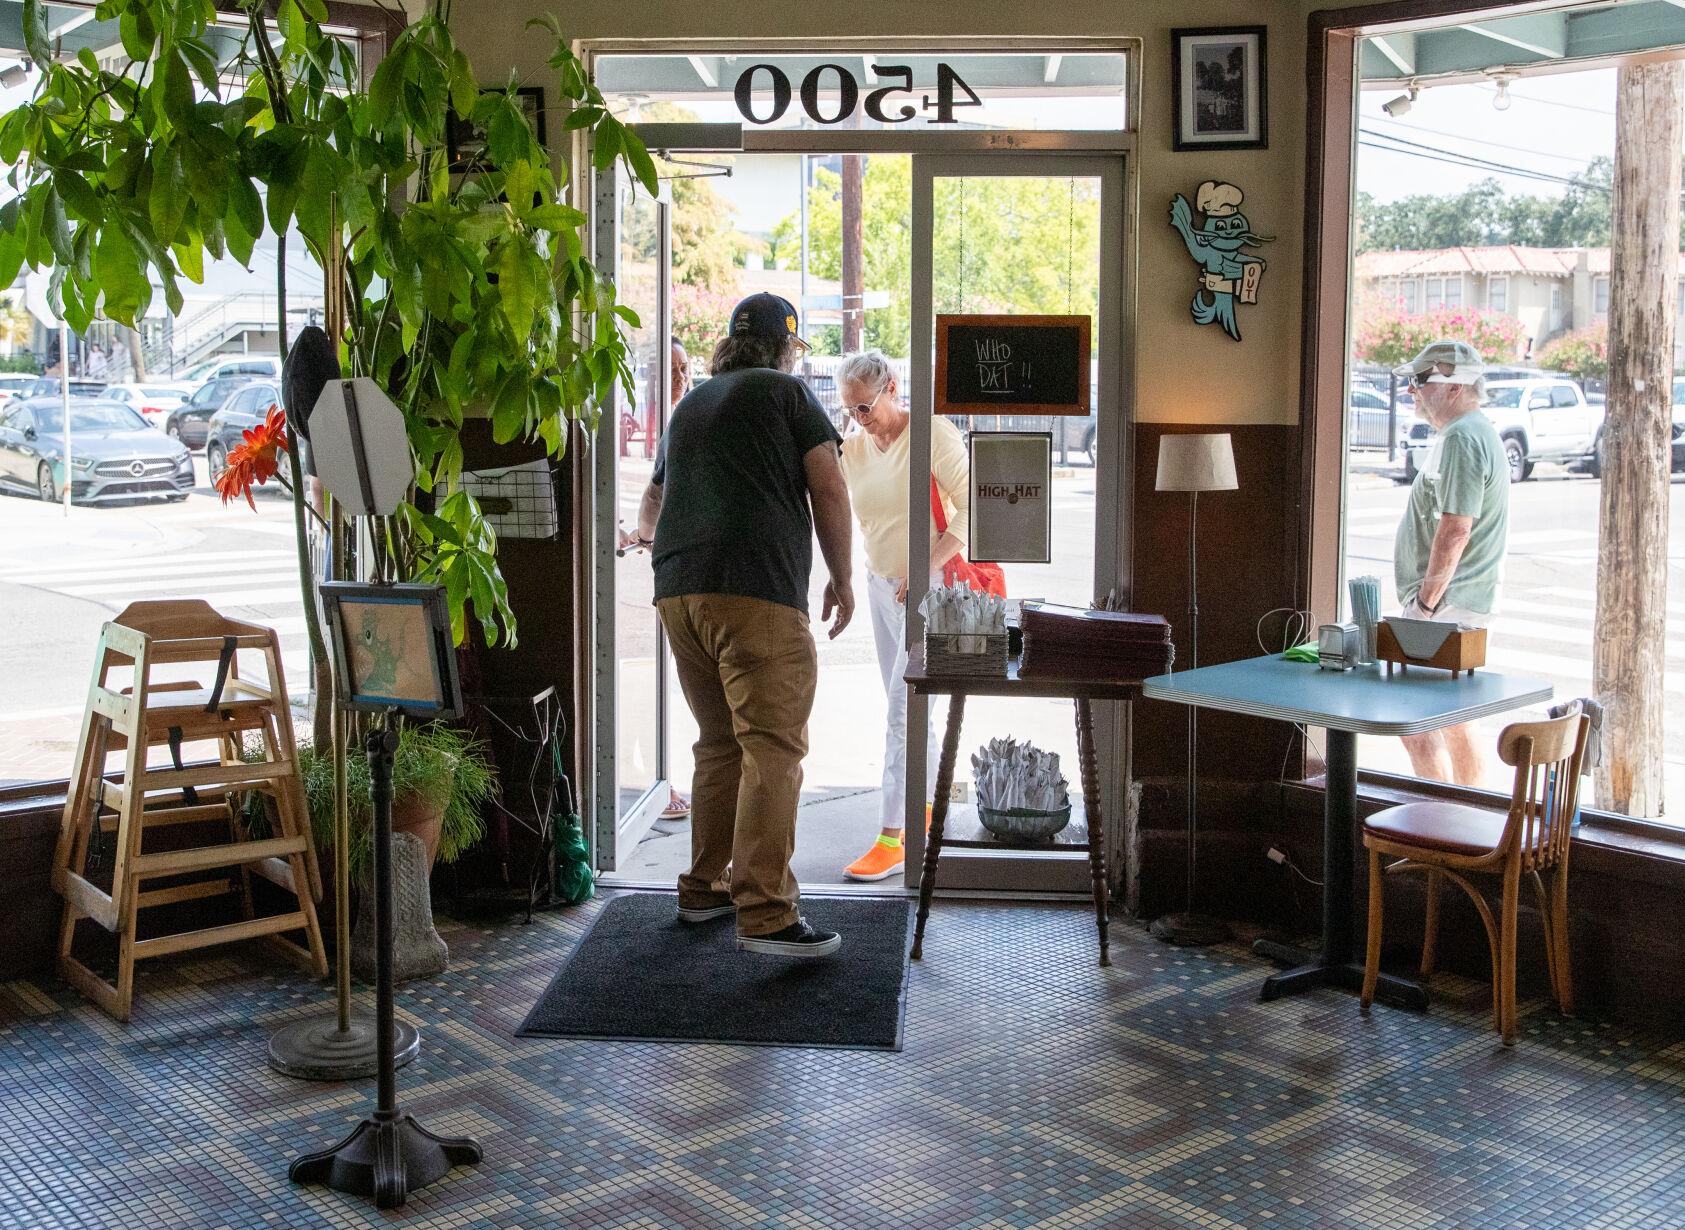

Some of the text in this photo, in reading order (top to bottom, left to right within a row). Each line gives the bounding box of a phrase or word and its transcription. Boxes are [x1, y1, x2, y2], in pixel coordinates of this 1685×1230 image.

[1245, 266, 1256, 299] OUT
[975, 339, 1011, 362] WHO
[975, 362, 1013, 389] DAT
[978, 484, 1042, 498] HIGH HAT
